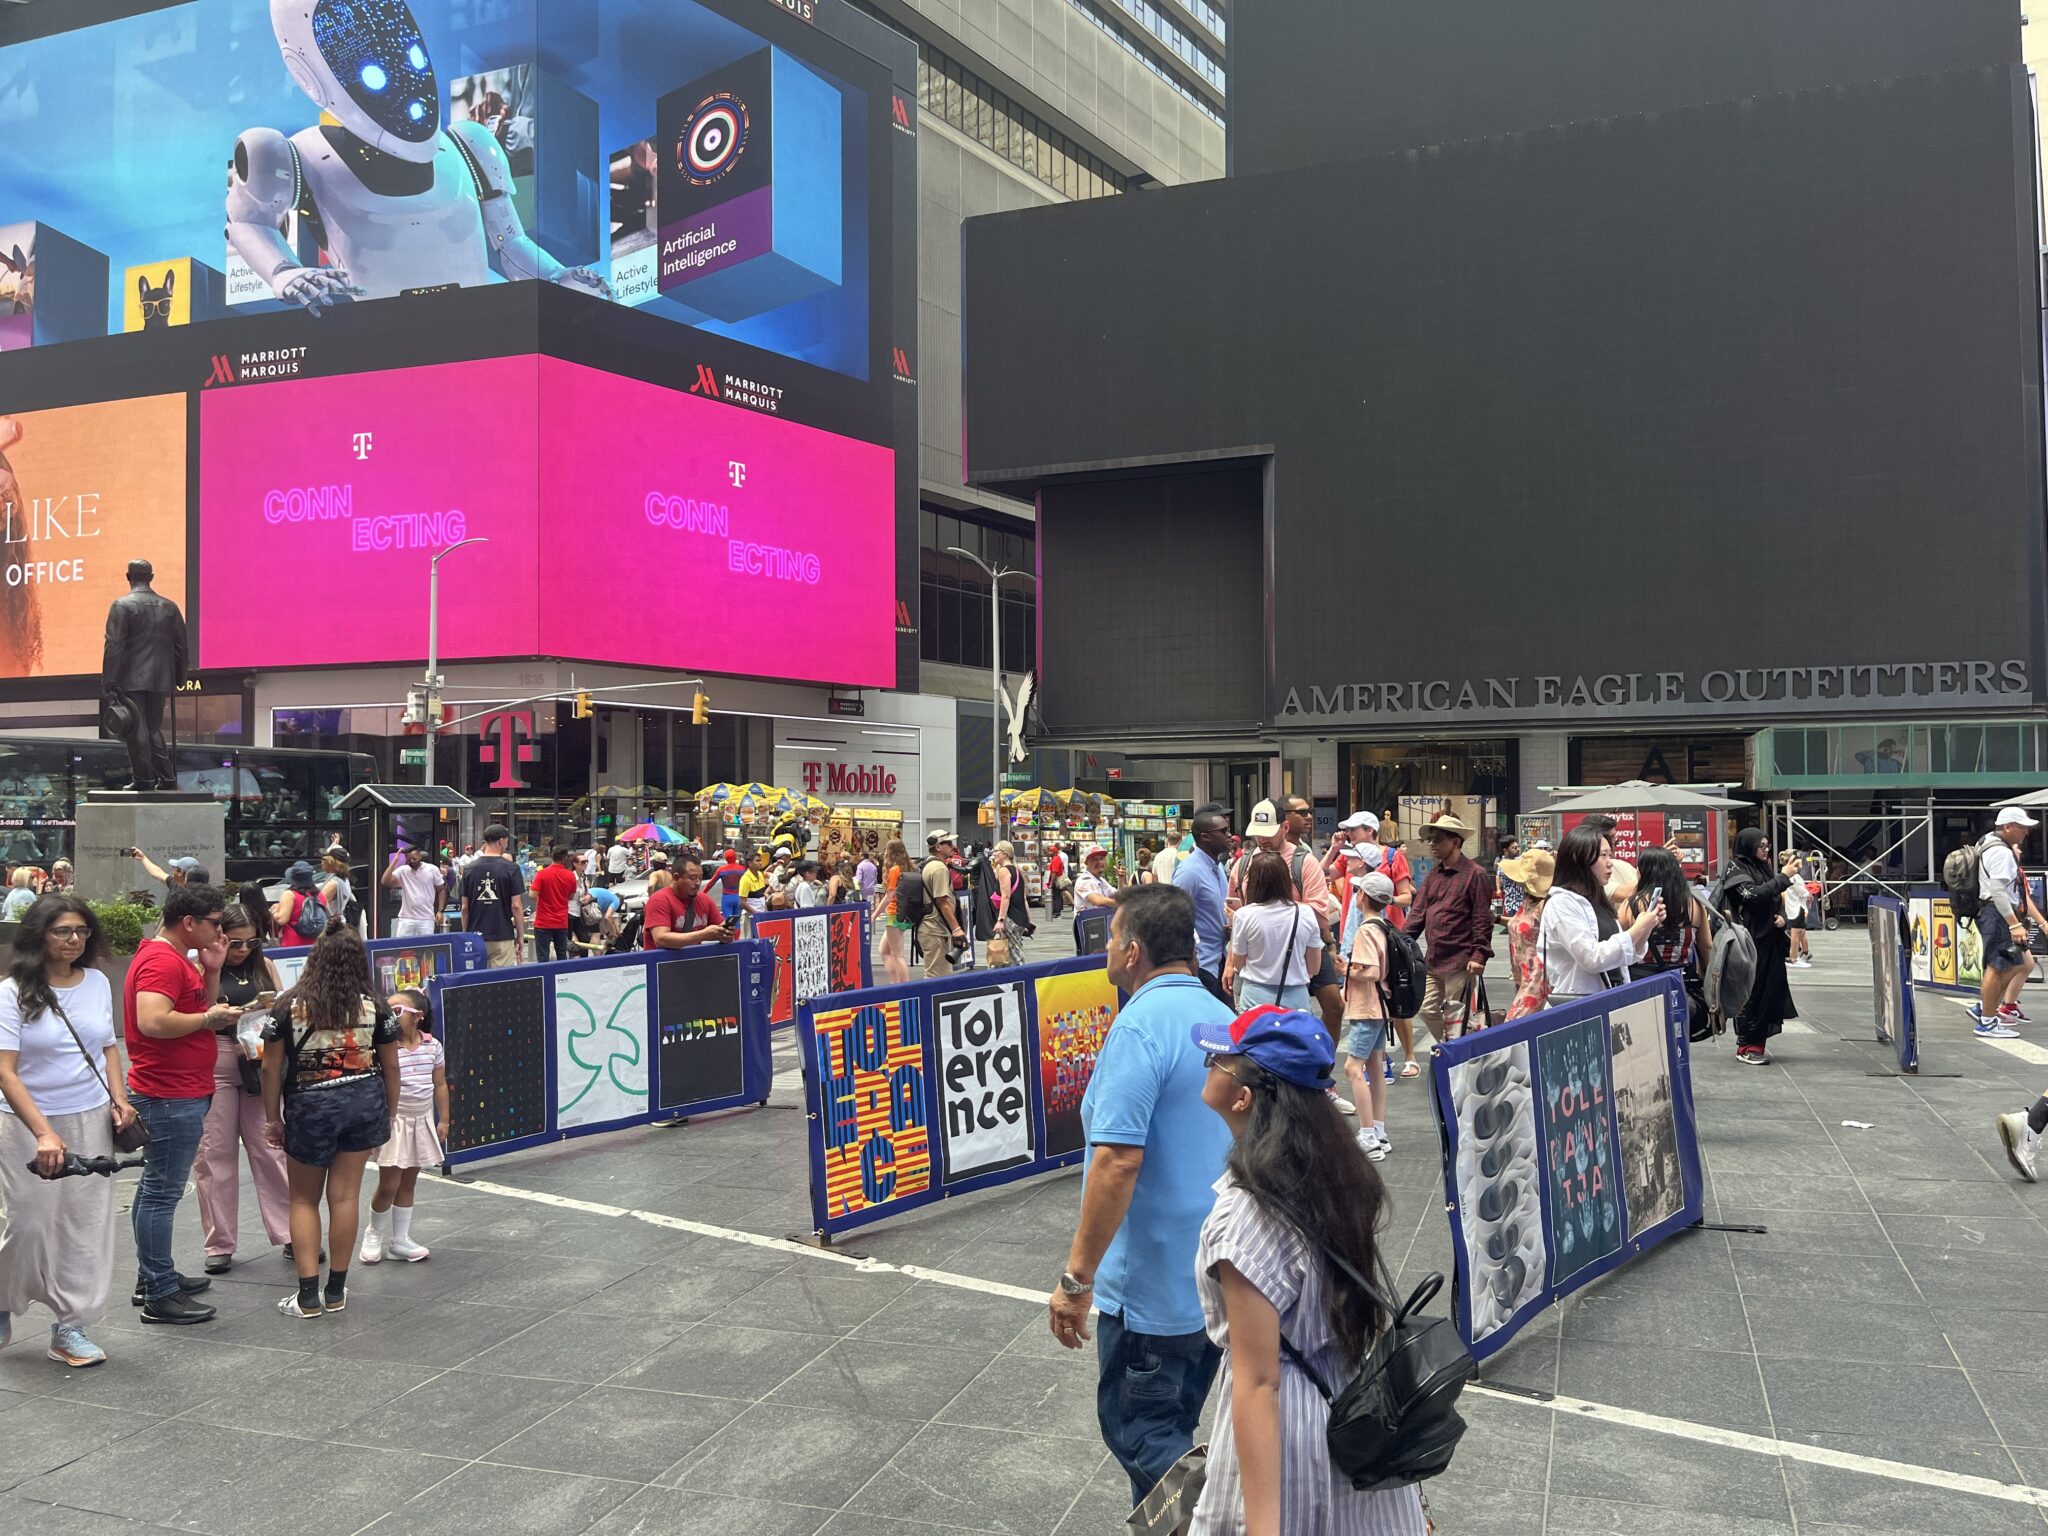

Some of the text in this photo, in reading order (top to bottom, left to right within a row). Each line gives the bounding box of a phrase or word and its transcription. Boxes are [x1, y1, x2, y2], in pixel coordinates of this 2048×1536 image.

[663, 223, 715, 256] Artificial
[616, 263, 648, 283] Active
[664, 239, 737, 276] Intelligence
[230, 280, 263, 293] Lifestyle
[616, 278, 658, 299] Lifestyle
[241, 347, 307, 364] MARRIOTT
[241, 362, 299, 378] MARQUIS
[725, 374, 783, 399] MARRIOTT
[725, 388, 777, 411] MARQUIS
[353, 432, 372, 460] T
[729, 461, 746, 488] T
[5, 493, 100, 543] LIKE
[264, 484, 352, 524] CONN
[645, 491, 728, 537] CONN
[352, 510, 466, 552] ECTING
[6, 559, 84, 586] OFFICE
[728, 540, 820, 584] ECTING
[1282, 659, 2029, 714] AMERICAN EAGLE OUTFITTERS
[480, 711, 541, 788] T
[827, 763, 896, 794] Mobile
[1467, 797, 1491, 805] DAY
[815, 997, 922, 1079] TOL
[942, 997, 1003, 1049] Tol
[1199, 1039, 1230, 1052] RANGERS
[946, 1045, 1021, 1092] era
[948, 1087, 1023, 1137] nce
